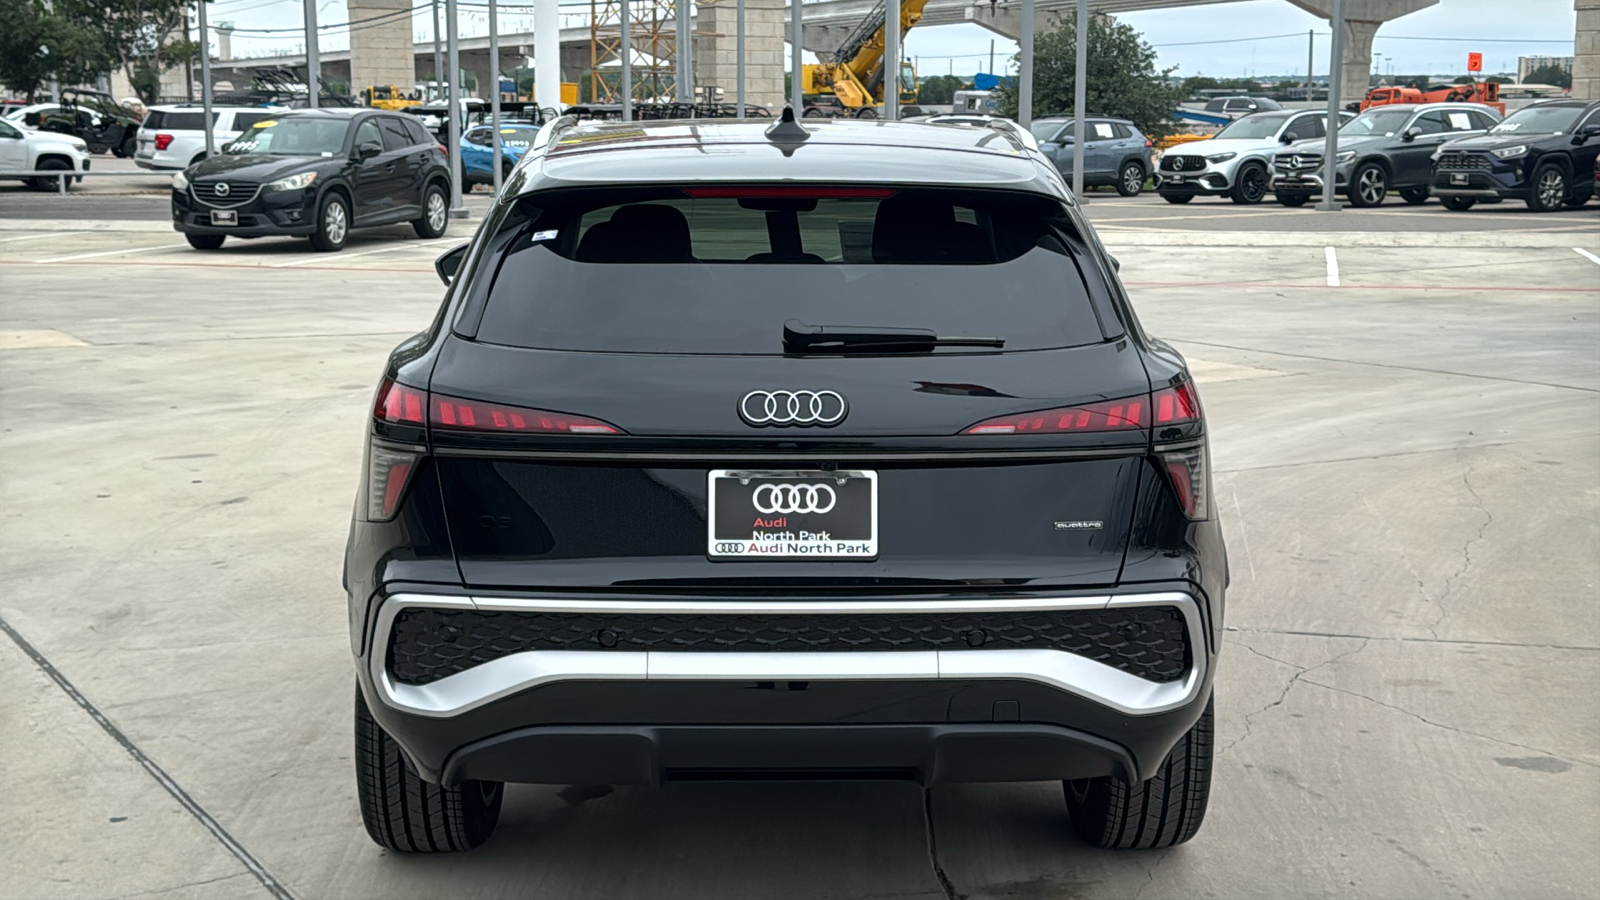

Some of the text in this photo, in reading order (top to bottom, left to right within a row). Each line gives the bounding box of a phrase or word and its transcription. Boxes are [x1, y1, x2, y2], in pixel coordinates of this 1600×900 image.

[753, 517, 787, 528] Audi
[753, 531, 831, 541] North Park
[748, 543, 870, 554] Audi North Park
